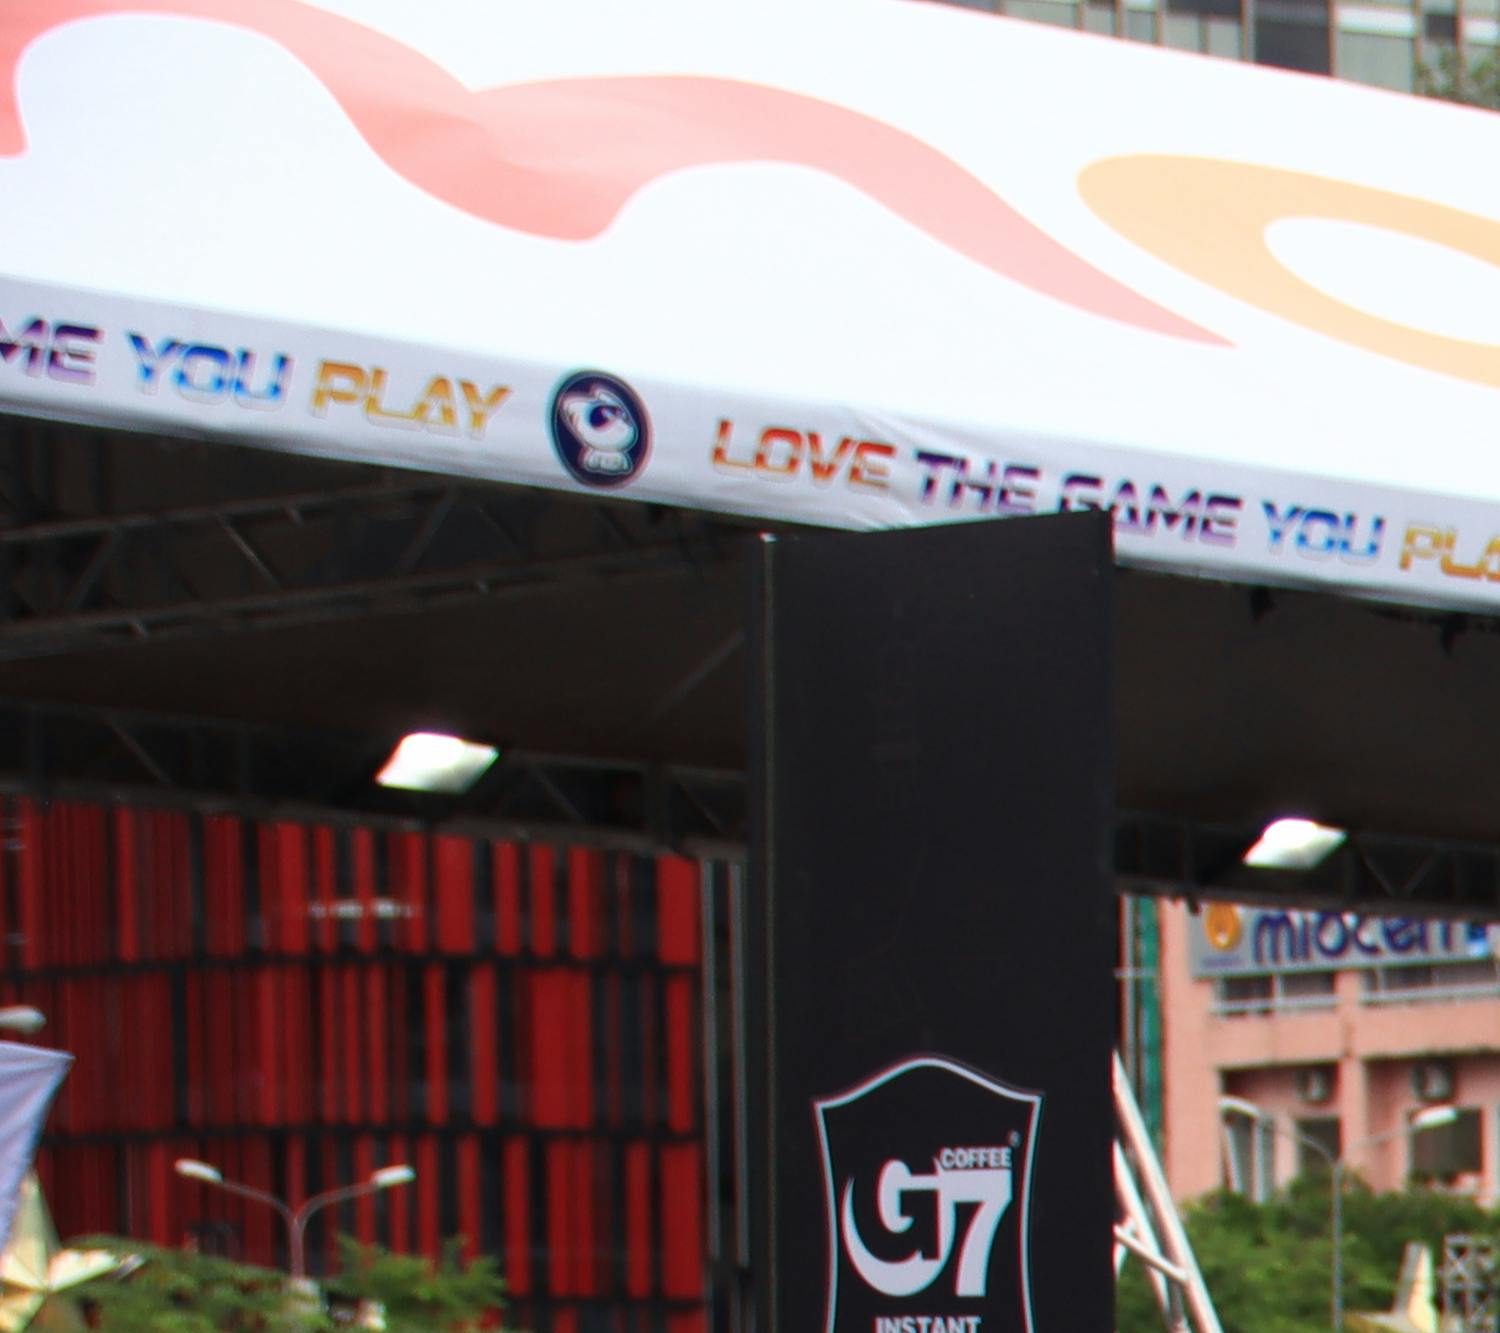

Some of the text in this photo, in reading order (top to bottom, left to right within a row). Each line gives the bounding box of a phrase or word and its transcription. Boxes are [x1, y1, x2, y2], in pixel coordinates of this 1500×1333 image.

[126, 330, 513, 440] YOU PLAY
[711, 418, 898, 492] LOVE
[914, 448, 1041, 516] THE
[1058, 472, 1244, 548] GAME
[1259, 500, 1388, 563] YOU
[939, 1146, 1012, 1169] COFFEE
[841, 1157, 1013, 1298] G7
